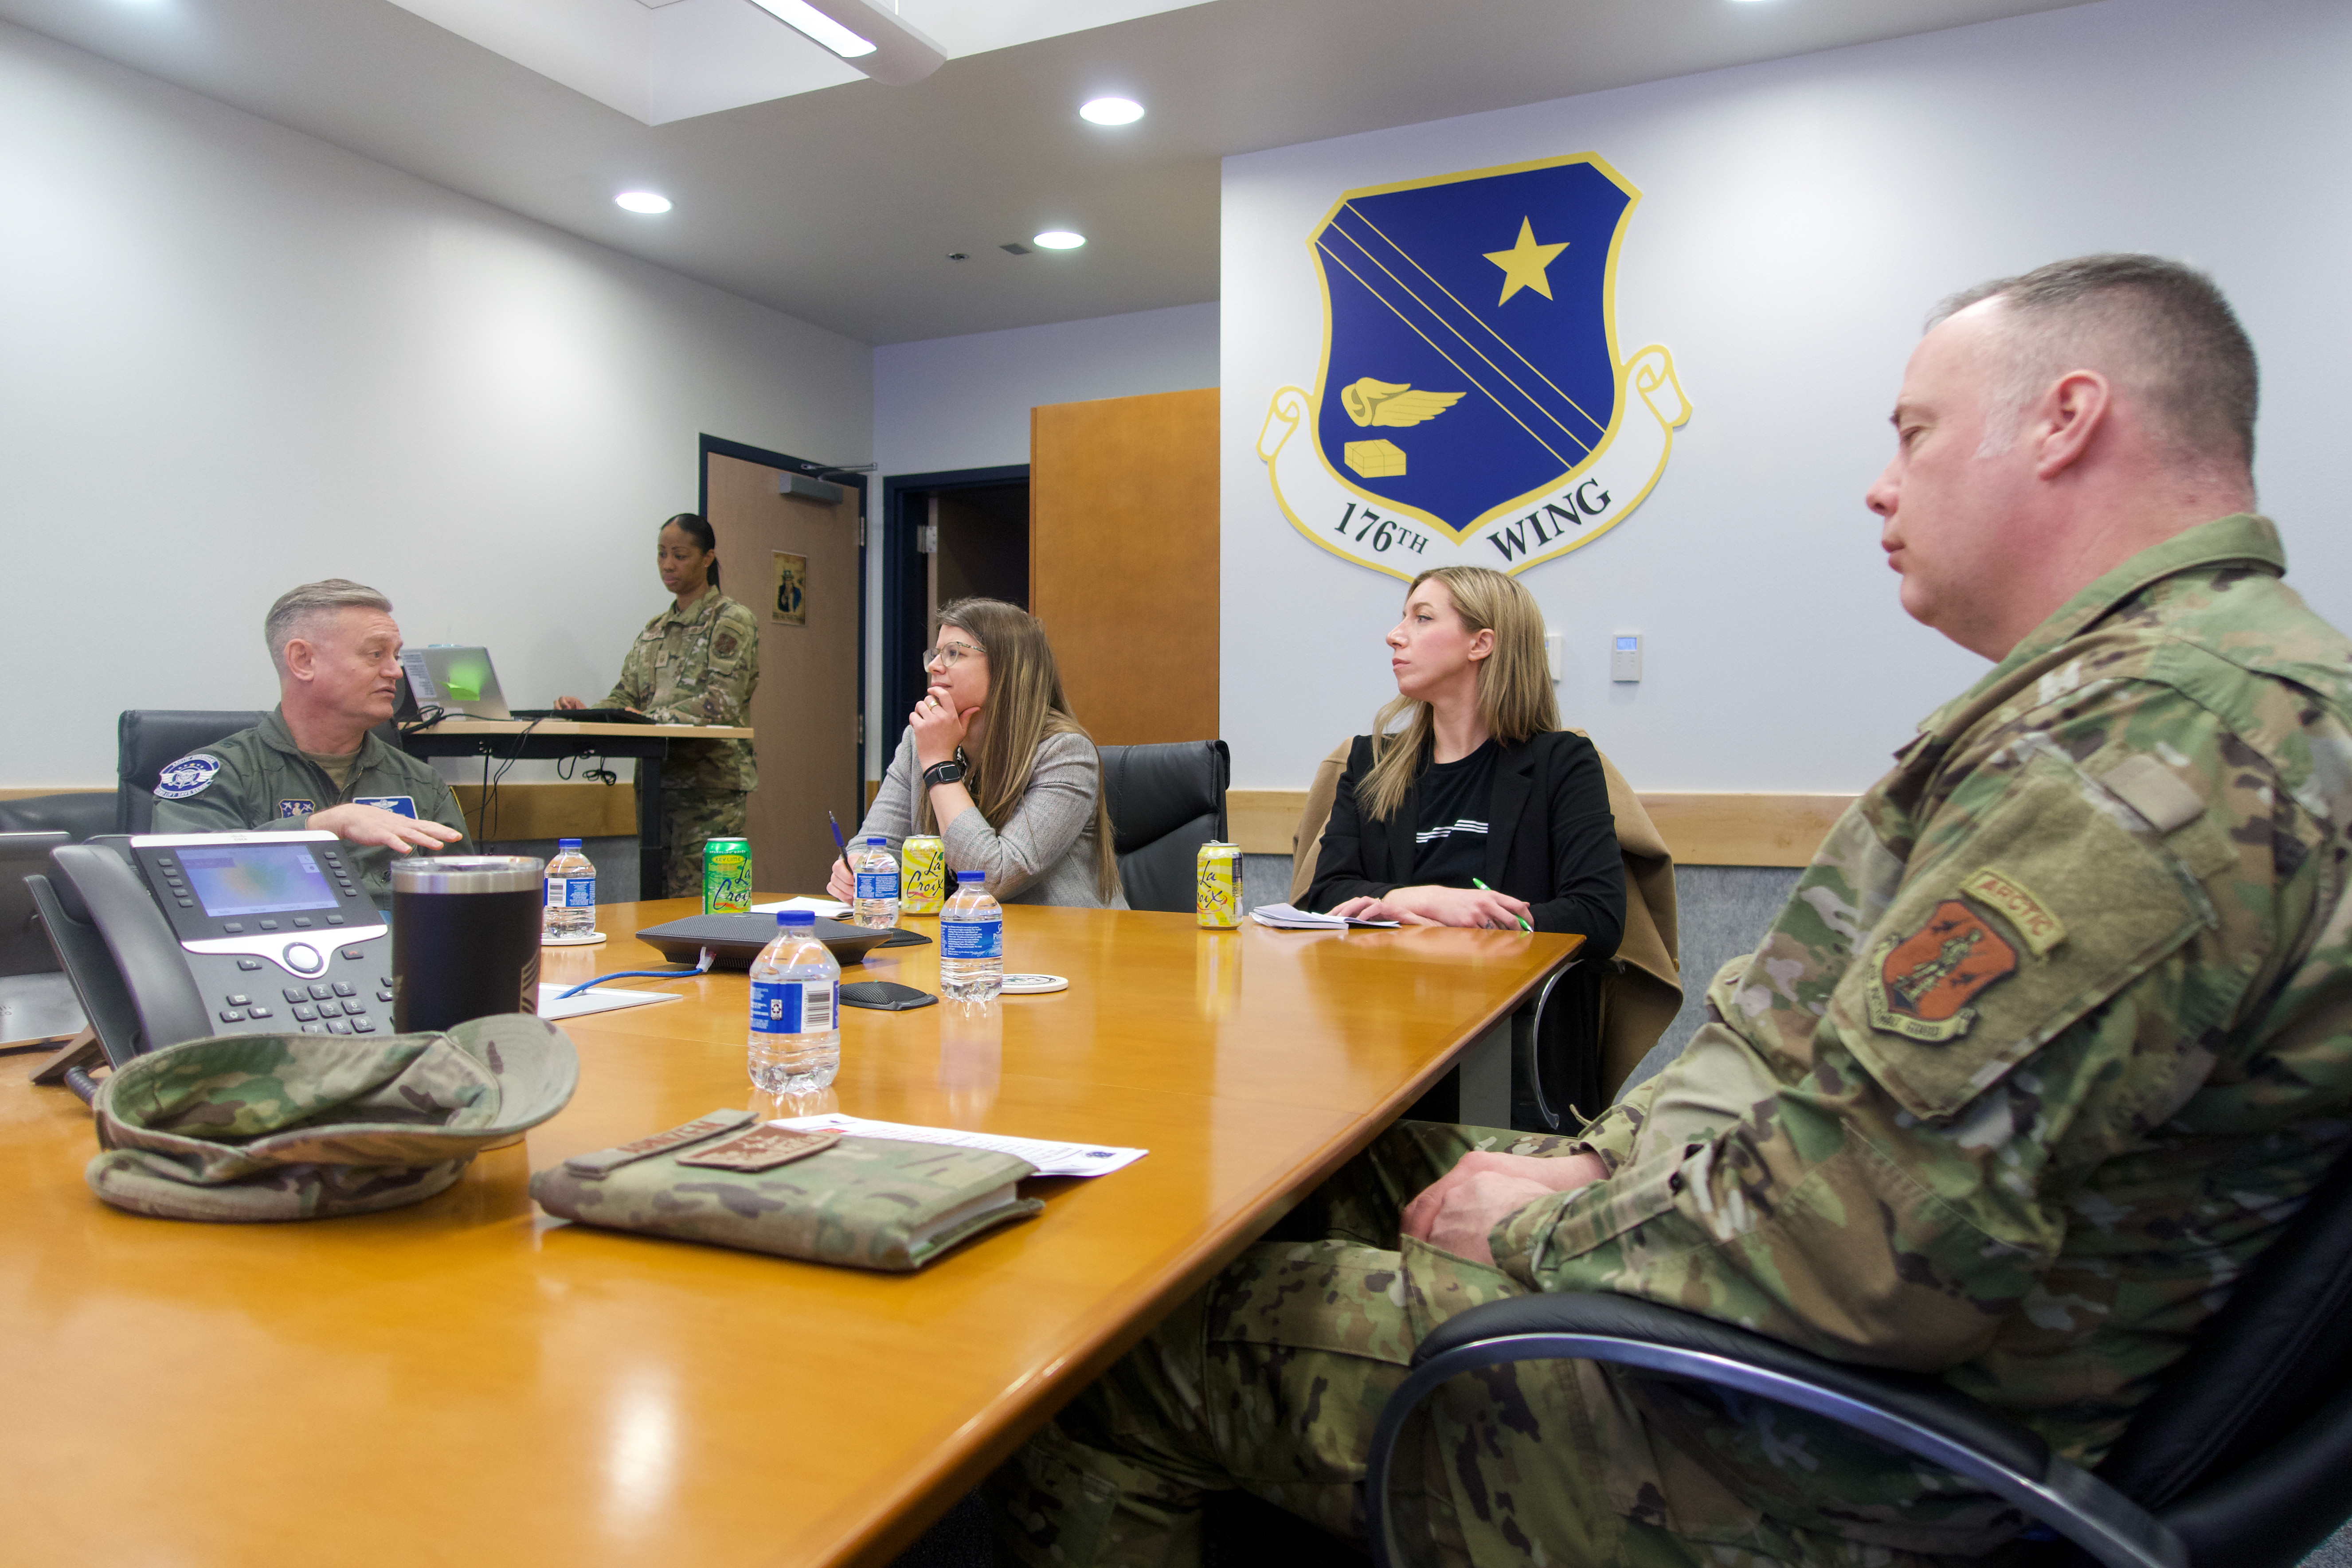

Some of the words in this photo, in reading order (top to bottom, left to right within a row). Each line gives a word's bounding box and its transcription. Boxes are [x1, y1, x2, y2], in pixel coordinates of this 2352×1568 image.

[1334, 502, 1429, 555] 176TH
[1486, 477, 1612, 563] WING
[735, 857, 751, 885] La
[924, 851, 941, 877] La
[1199, 860, 1217, 888] La
[907, 870, 943, 898] Croix
[1197, 890, 1224, 908] roix
